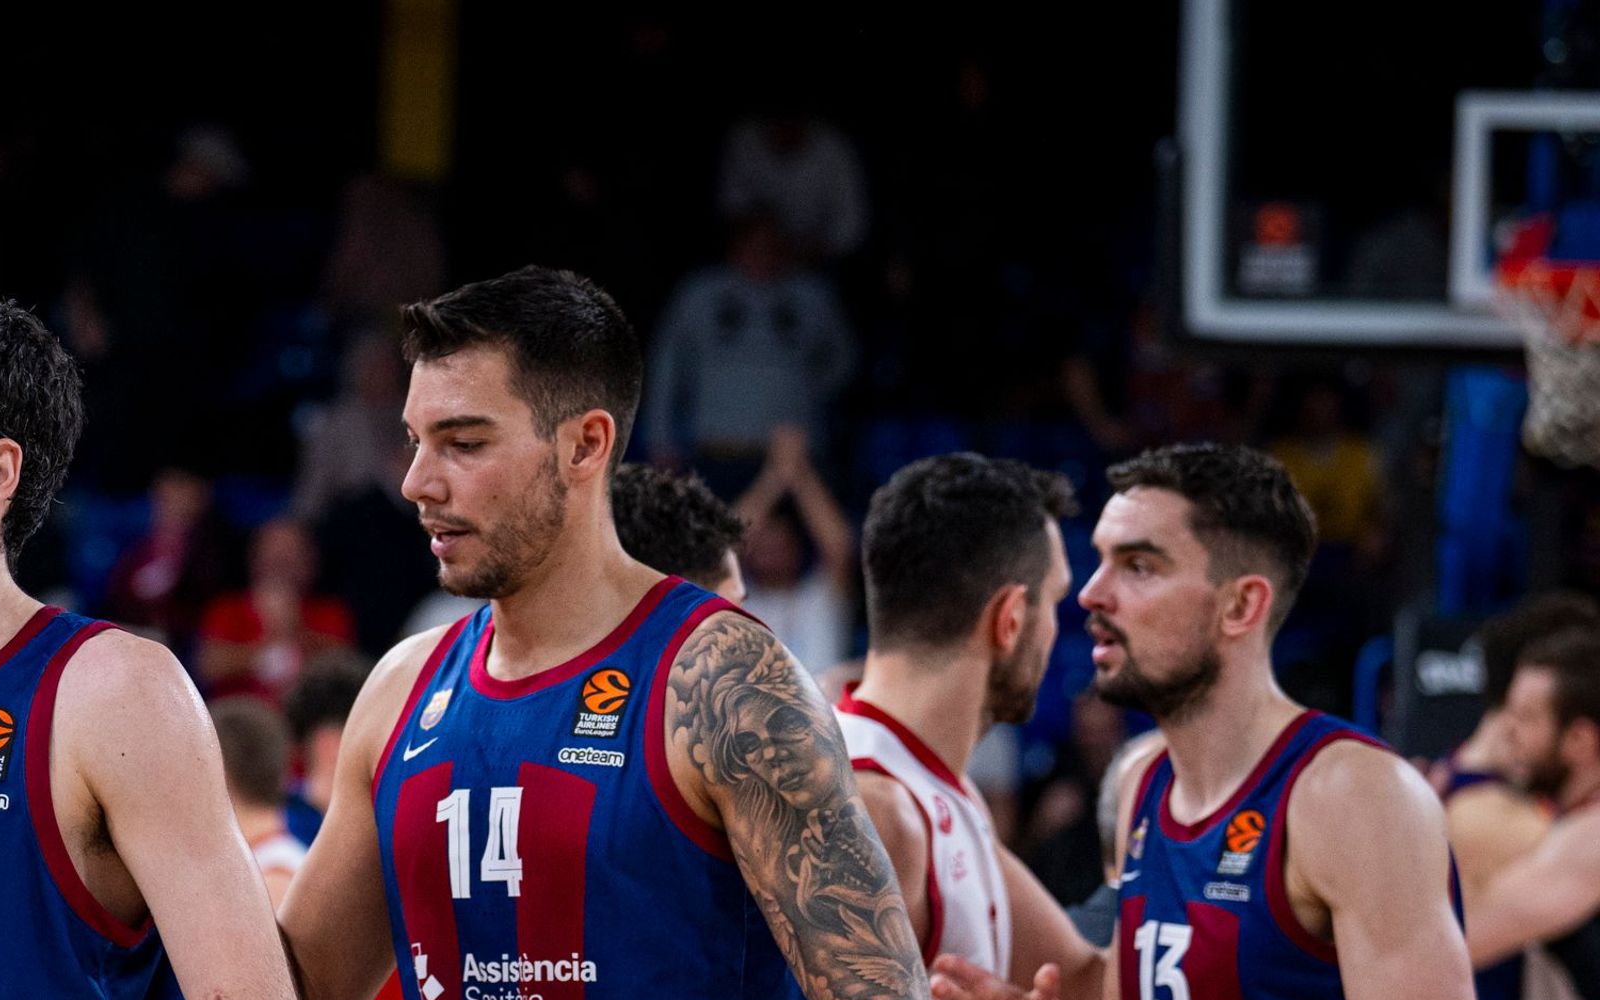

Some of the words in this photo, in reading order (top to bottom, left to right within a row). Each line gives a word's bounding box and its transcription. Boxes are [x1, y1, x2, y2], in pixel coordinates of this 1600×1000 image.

[576, 721, 617, 730] AIRLINES
[579, 713, 619, 723] TURKISH
[559, 748, 624, 766] oneteam
[436, 787, 523, 899] 14
[463, 952, 597, 983] Assistència
